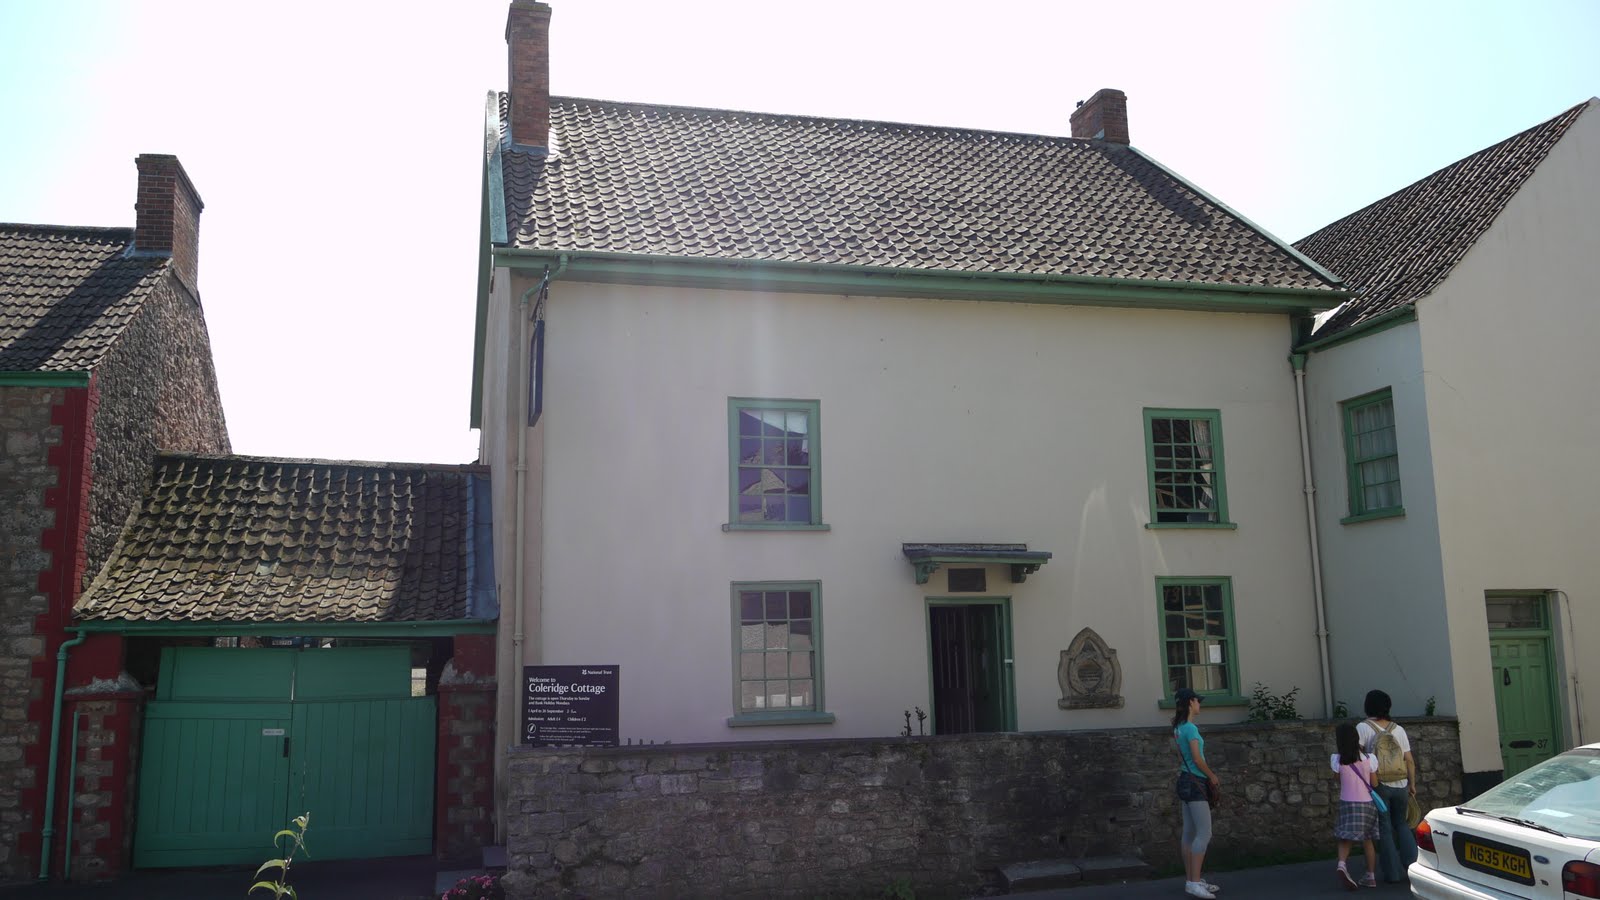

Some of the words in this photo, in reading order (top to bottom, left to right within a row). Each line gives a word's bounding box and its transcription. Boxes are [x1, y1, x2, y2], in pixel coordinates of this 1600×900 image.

[528, 683, 569, 694] Coleridge
[570, 683, 605, 694] Cottage
[1538, 738, 1548, 748] 37
[1470, 846, 1499, 866] N635
[1502, 854, 1526, 874] KGH
